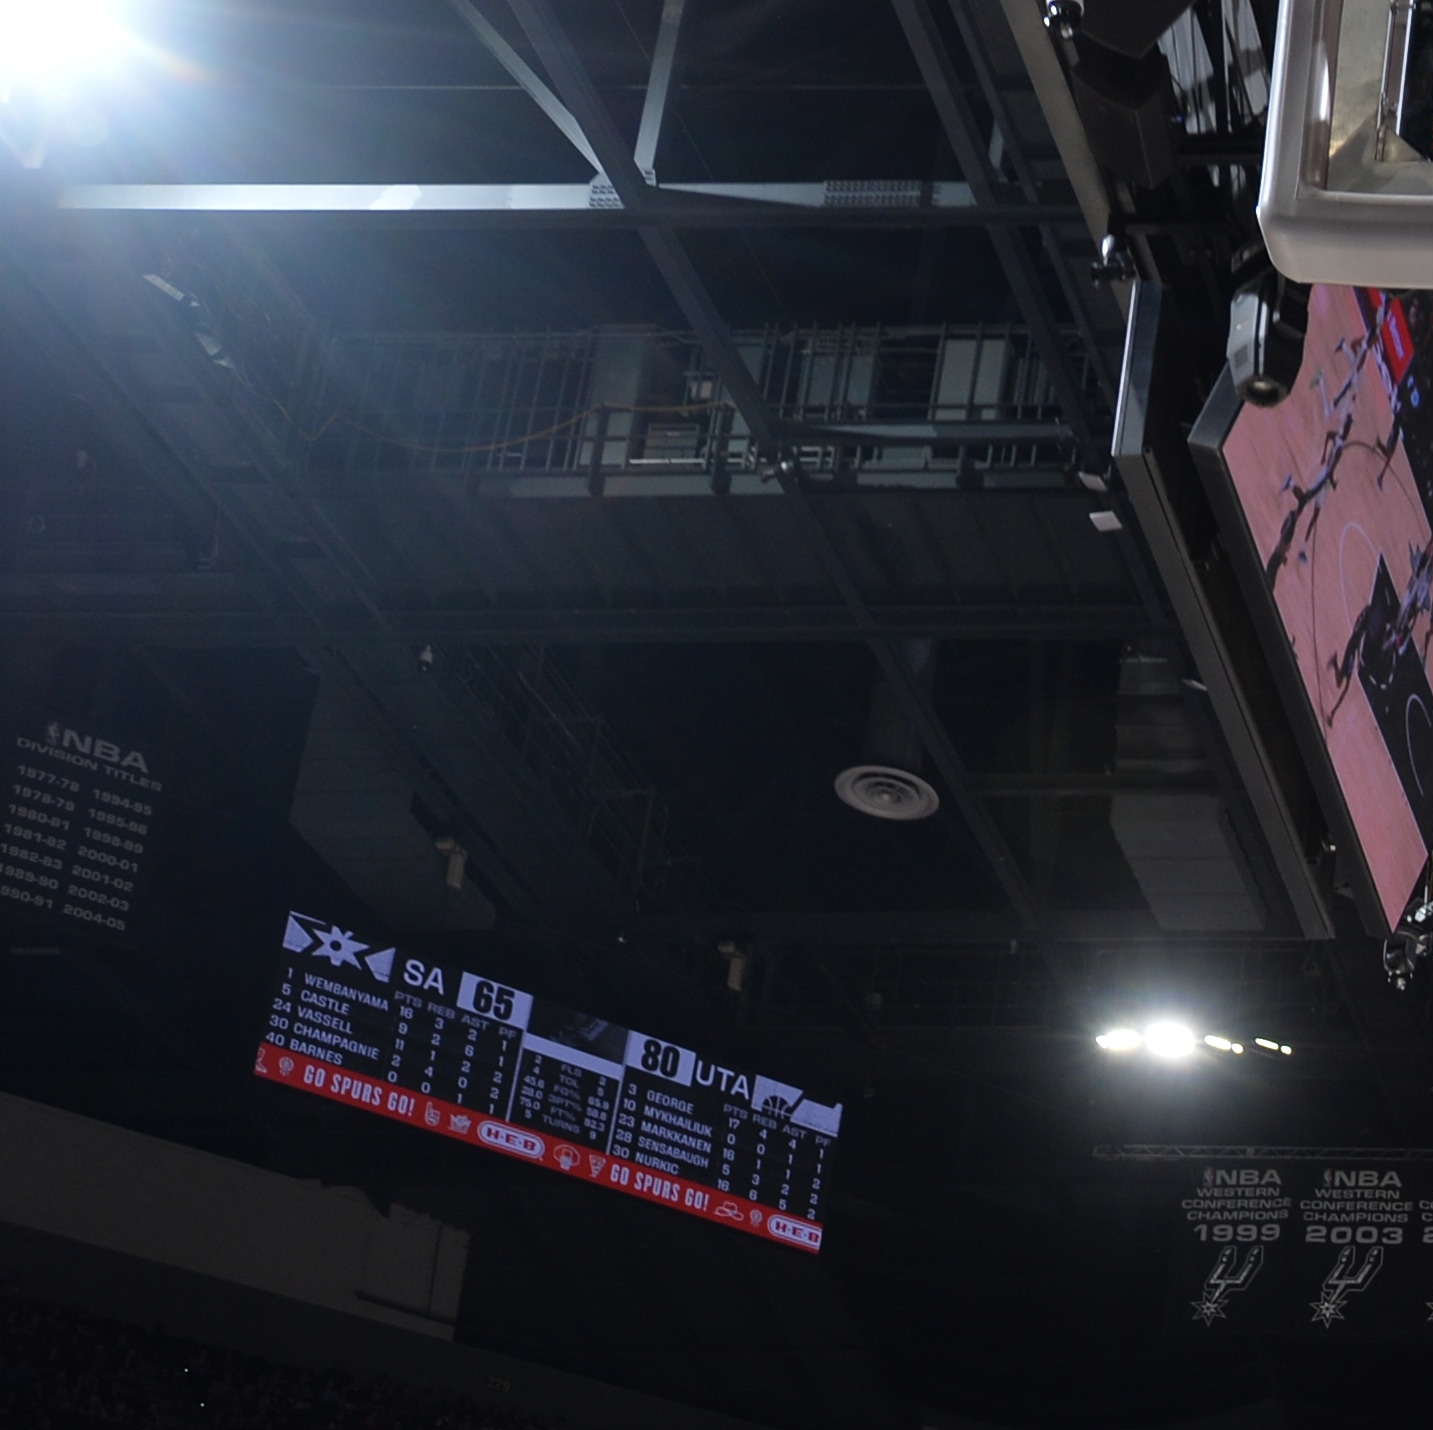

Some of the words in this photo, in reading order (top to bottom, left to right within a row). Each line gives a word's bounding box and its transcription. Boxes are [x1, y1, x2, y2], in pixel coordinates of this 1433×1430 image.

[305, 973, 389, 1012] WEMBANYAMA
[403, 959, 445, 995] SA
[272, 998, 291, 1014] 24
[297, 1005, 353, 1035] VASSELL
[301, 990, 351, 1016] CASTLE
[472, 980, 516, 1022] 65
[266, 1032, 285, 1047] 40
[290, 1038, 344, 1065] BARNES
[269, 1015, 289, 1031] 30
[293, 1021, 381, 1060] CHAMPAGNIE
[640, 1039, 680, 1078] 80
[303, 1064, 326, 1088] GO
[330, 1072, 383, 1106] SPURS
[388, 1092, 416, 1117] GO!
[695, 1060, 749, 1100] UTA
[646, 1089, 694, 1115] GEORGE
[641, 1120, 712, 1154] MARKKANEN
[609, 1164, 630, 1186] GO
[634, 1171, 680, 1203] SPURS
[685, 1187, 710, 1211] GO!
[1216, 1169, 1281, 1185] NBA
[1334, 1171, 1402, 1187] NBA
[1193, 1224, 1280, 1241] 1999
[1305, 1226, 1403, 1244] 2003
